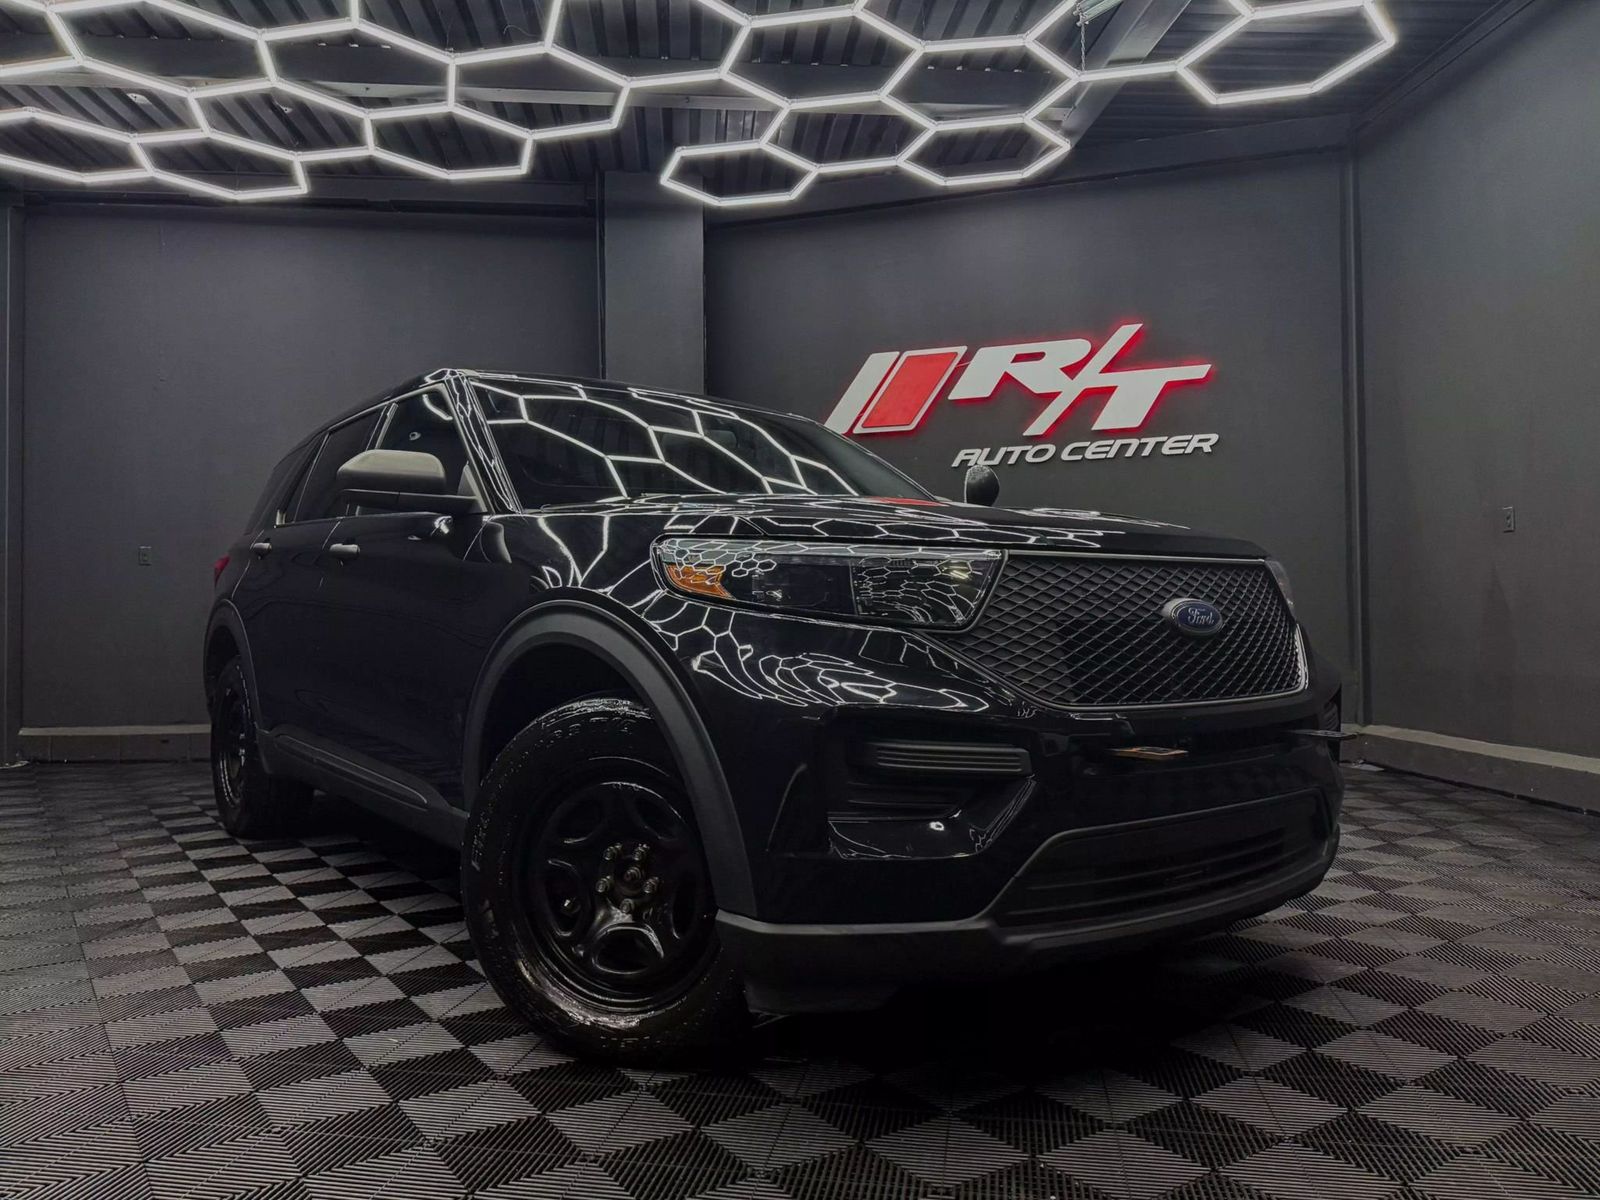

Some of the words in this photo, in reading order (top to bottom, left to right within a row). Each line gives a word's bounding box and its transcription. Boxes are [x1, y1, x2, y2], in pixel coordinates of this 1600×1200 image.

[951, 444, 1057, 468] AUTO
[1060, 433, 1220, 461] CENTER
[1187, 606, 1215, 625] Ford
